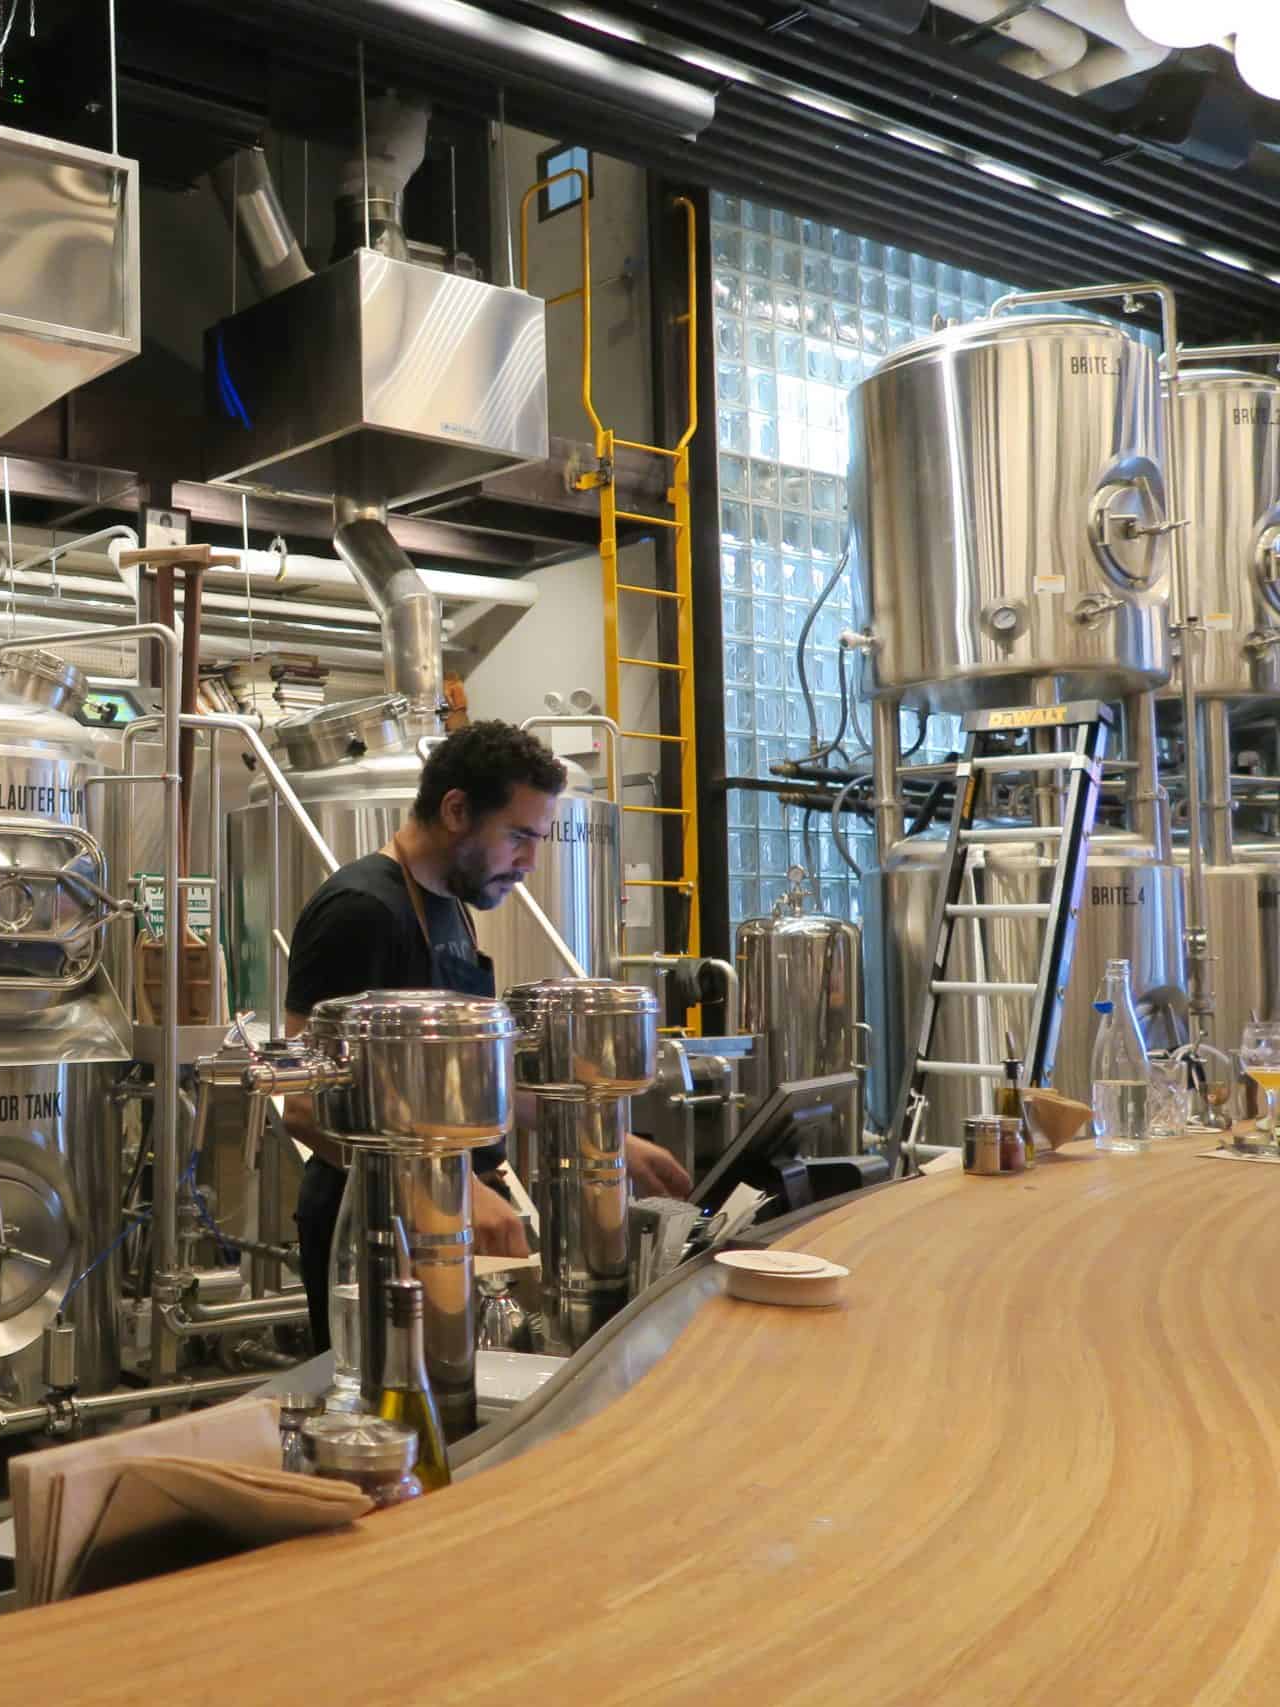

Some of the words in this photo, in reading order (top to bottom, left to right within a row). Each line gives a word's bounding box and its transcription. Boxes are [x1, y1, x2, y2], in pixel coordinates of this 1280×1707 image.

[60, 788, 84, 815] TUN
[1091, 886, 1145, 905] BRITE_4
[25, 1091, 62, 1120] TANK
